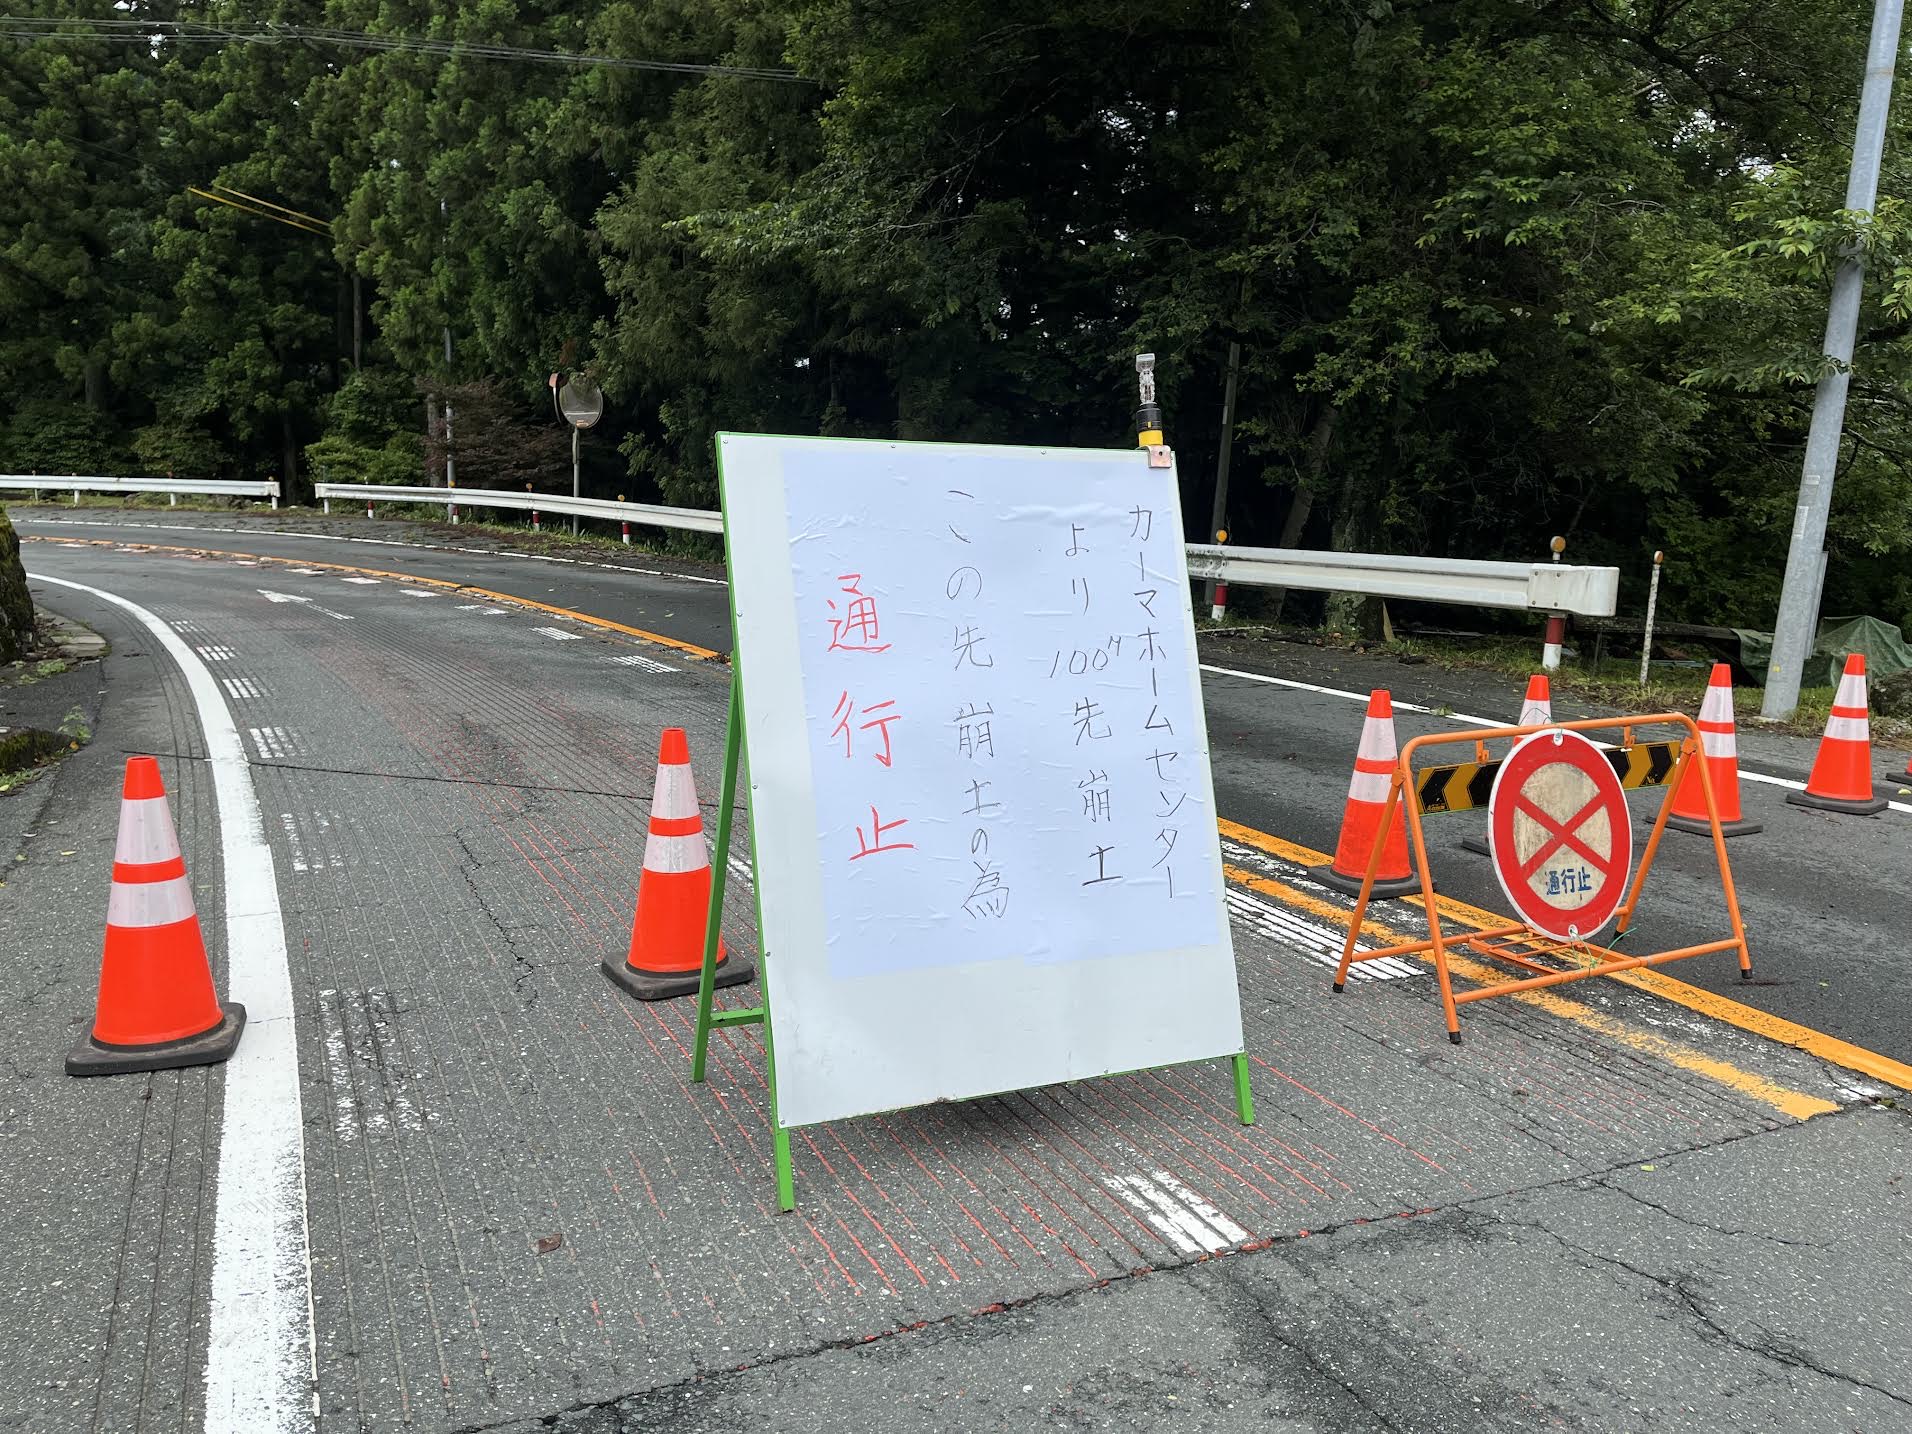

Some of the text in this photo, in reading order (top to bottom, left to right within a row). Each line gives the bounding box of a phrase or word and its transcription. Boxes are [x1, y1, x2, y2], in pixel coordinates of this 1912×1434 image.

[826, 573, 920, 862] 通行止
[946, 489, 1010, 920] この先崩土の為
[1128, 504, 1187, 900] カーマホームセンター
[1545, 865, 1592, 895] 通行止
